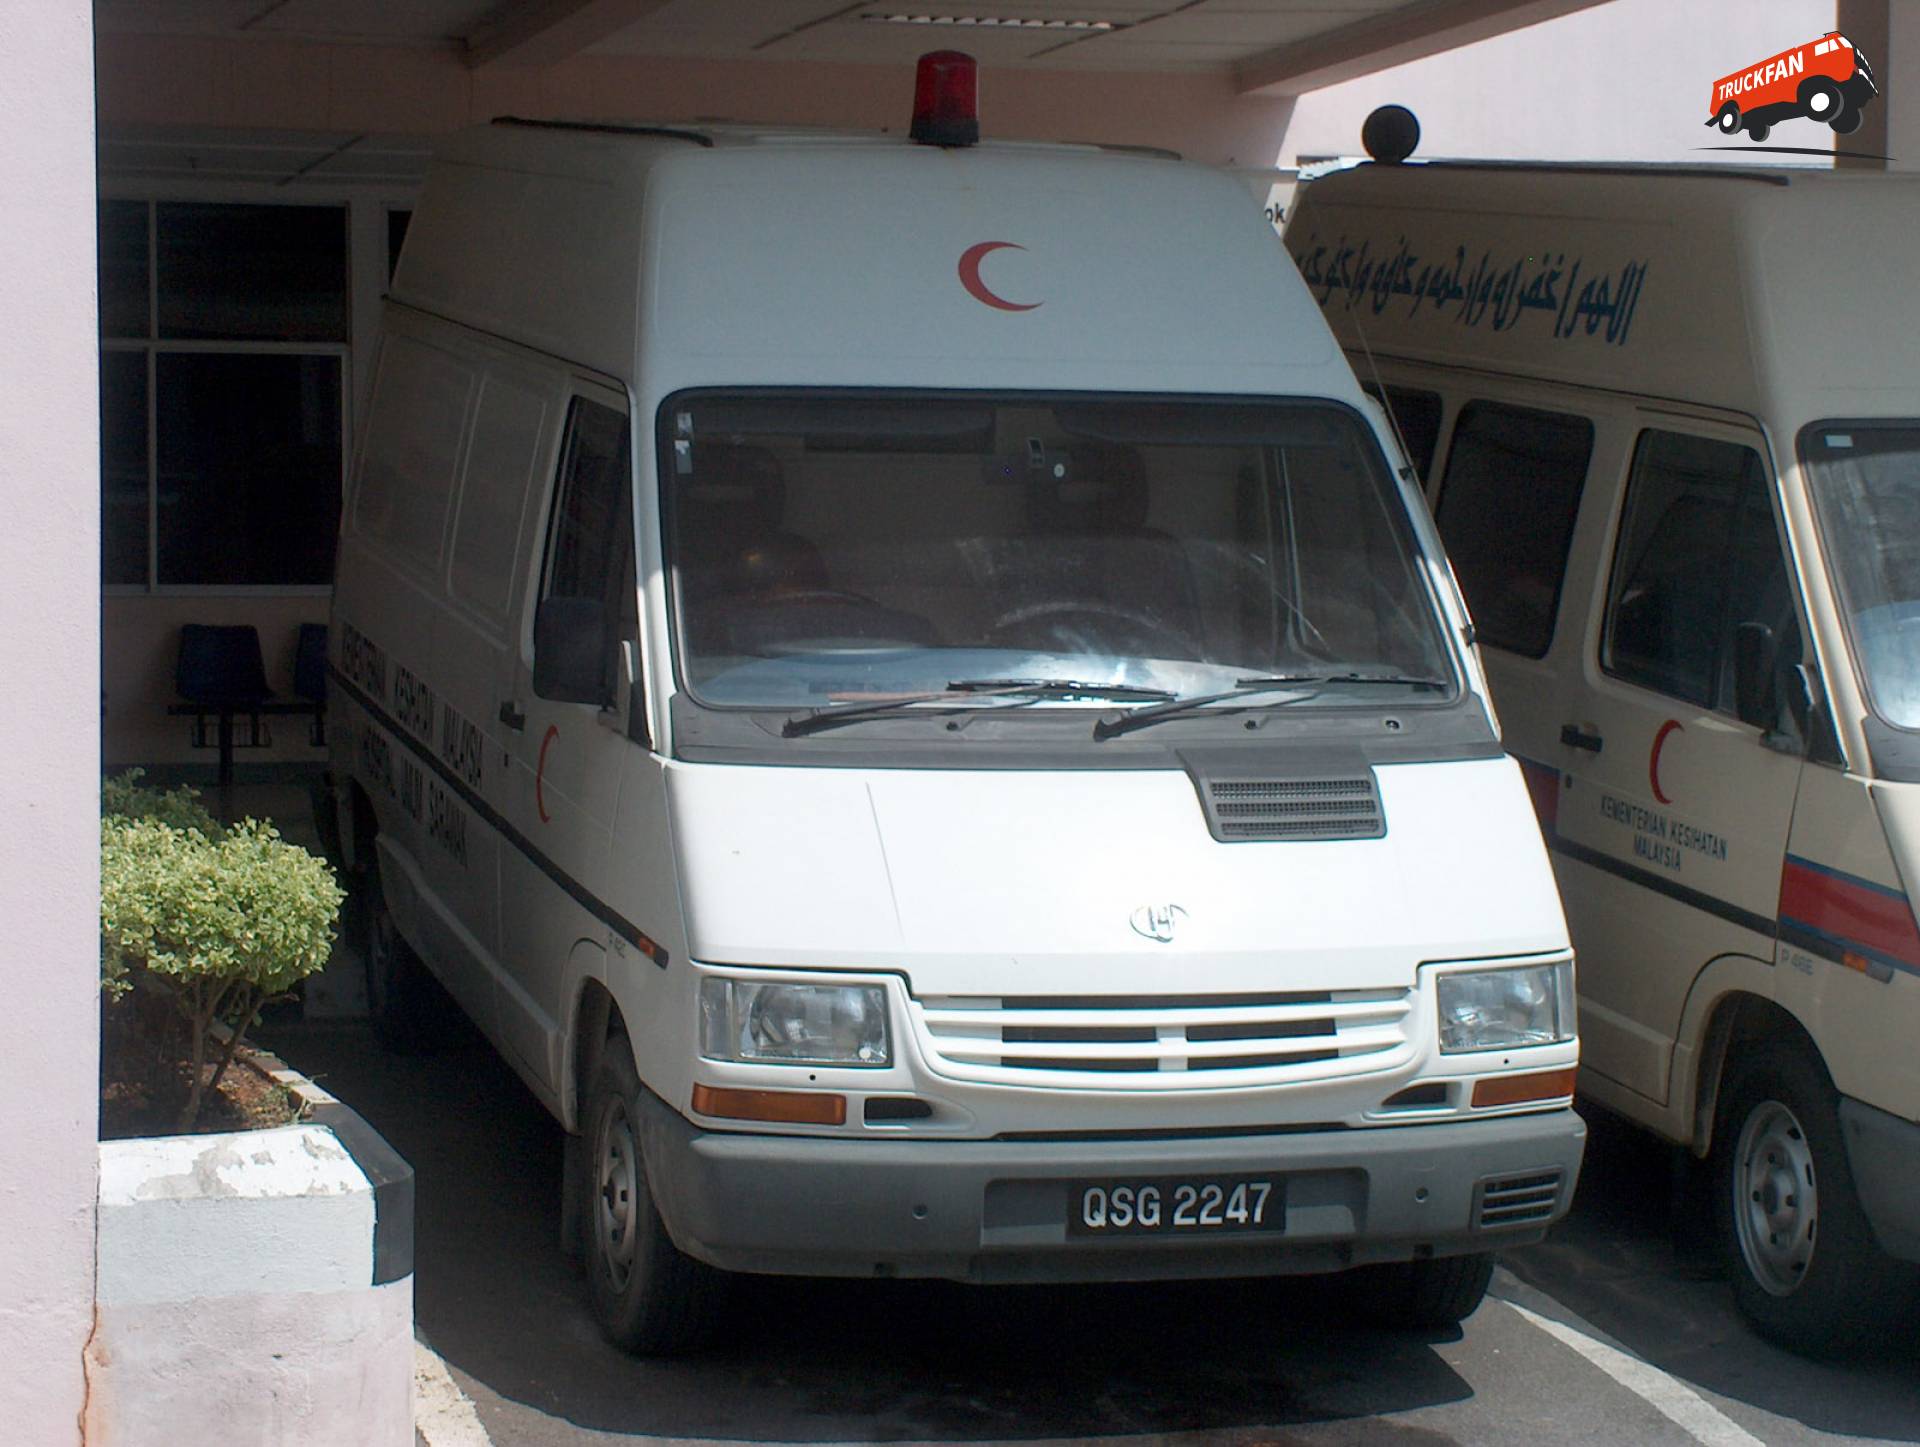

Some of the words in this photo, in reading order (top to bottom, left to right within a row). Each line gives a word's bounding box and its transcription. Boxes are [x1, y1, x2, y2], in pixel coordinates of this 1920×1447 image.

[1601, 794, 1667, 838] KEMENTERIAN
[1670, 819, 1728, 862] KESIHATAN
[1634, 834, 1681, 872] MALAYSIA
[1083, 1186, 1161, 1228] QSG
[1173, 1182, 1272, 1226] 2247
